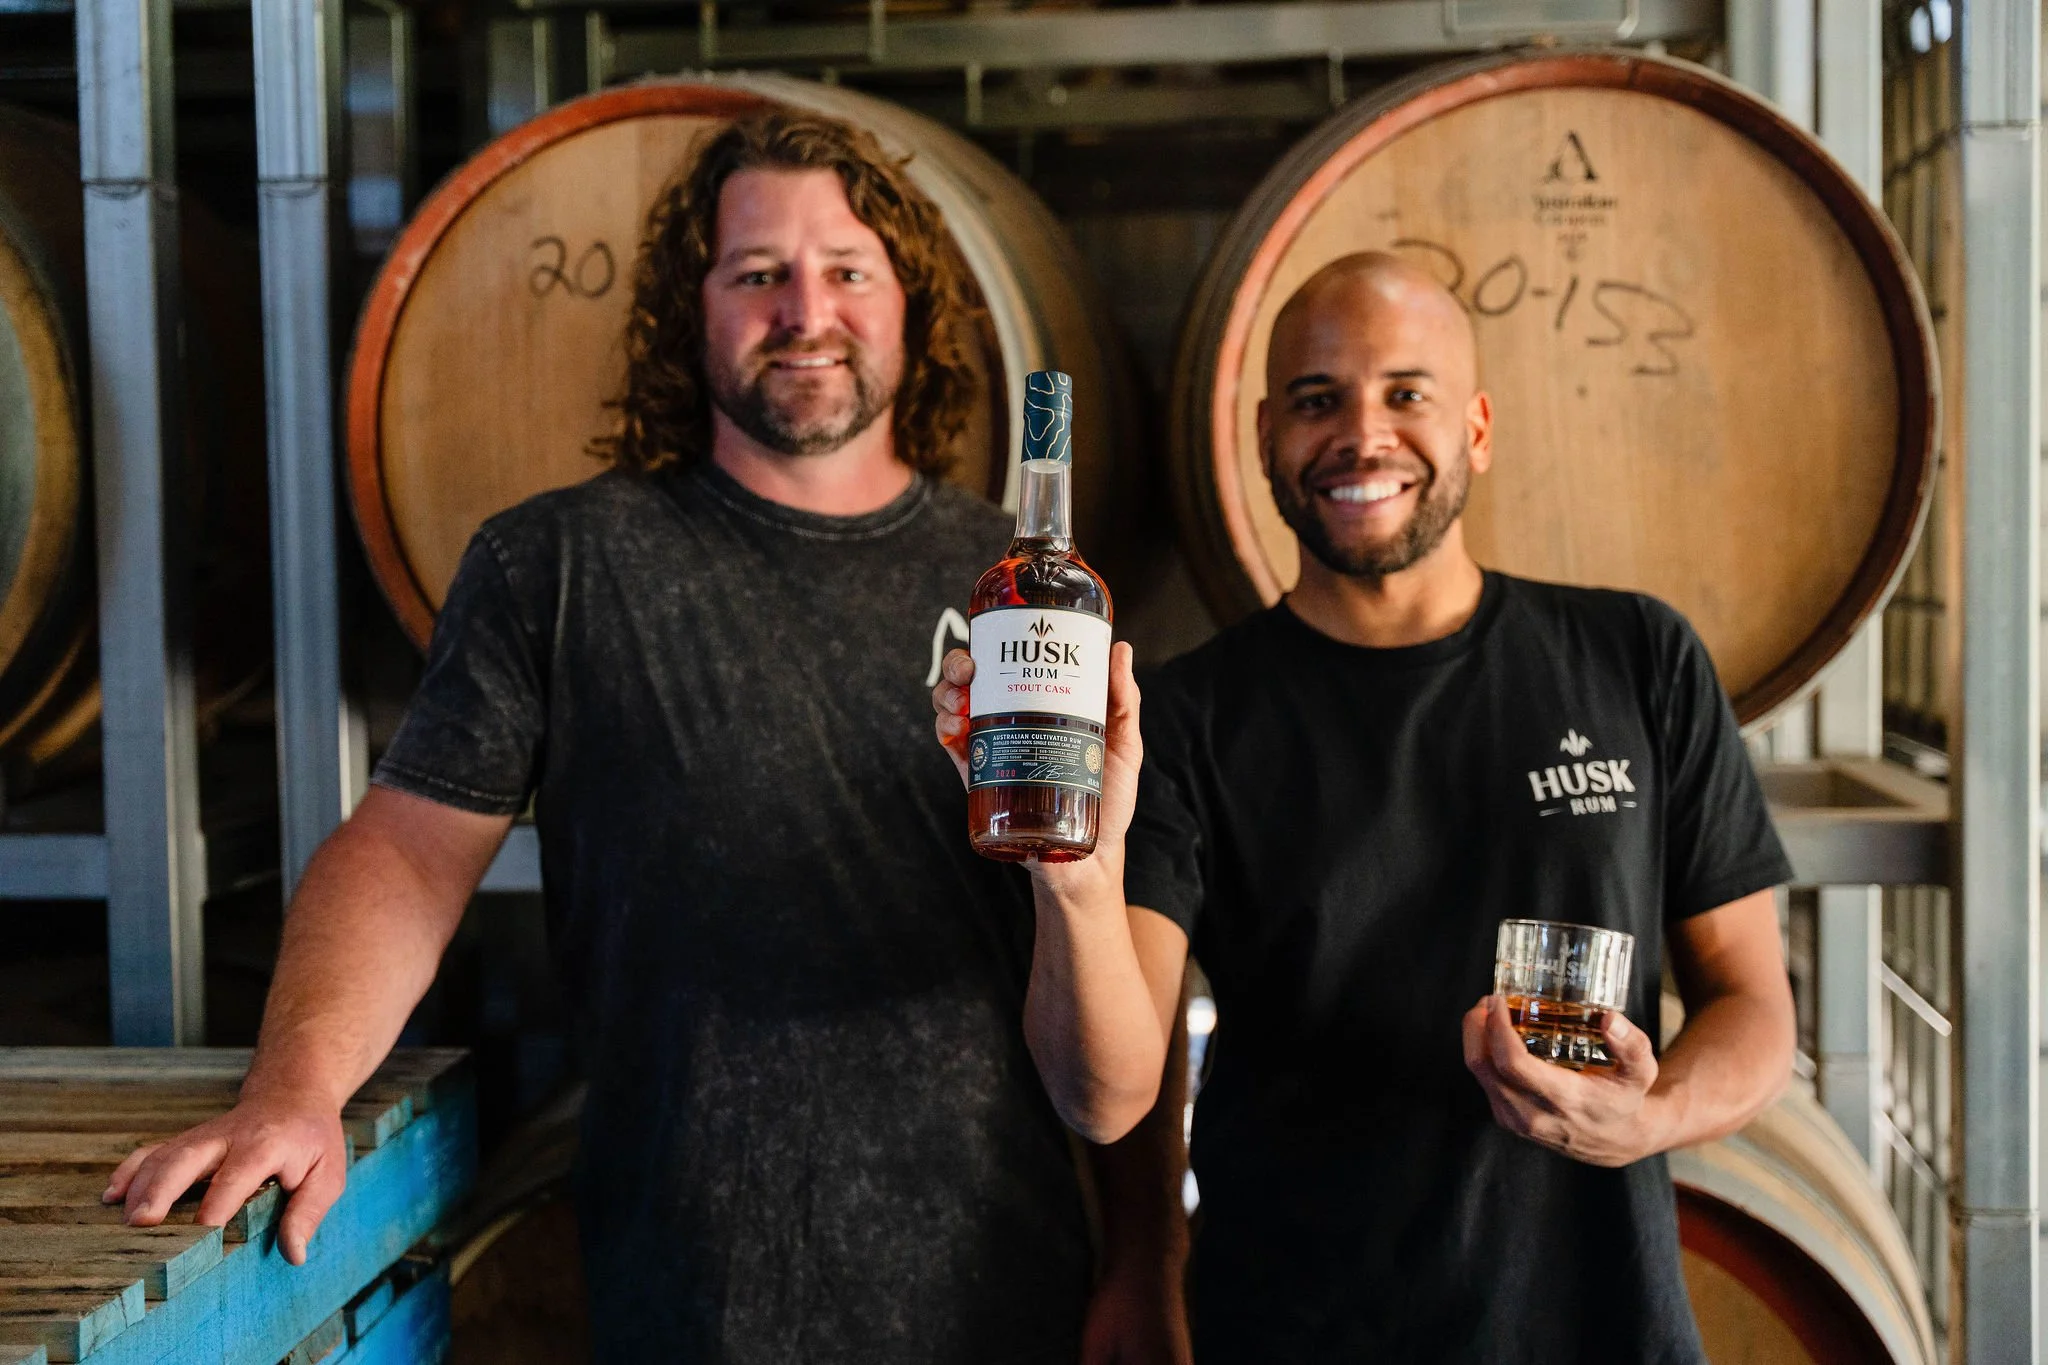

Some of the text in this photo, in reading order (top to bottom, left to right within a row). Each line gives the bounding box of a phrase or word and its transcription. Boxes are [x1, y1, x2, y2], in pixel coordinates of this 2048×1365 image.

[528, 235, 616, 299] 20
[1000, 640, 1080, 666] HUSK
[1022, 667, 1058, 680] RUM
[1007, 683, 1072, 695] STOUT CASK
[992, 733, 1082, 745] AUSTRALIAN CULTIVATED RUM
[995, 769, 1016, 778] 2020
[1527, 759, 1636, 802] HUSK
[1570, 796, 1617, 815] RUM
